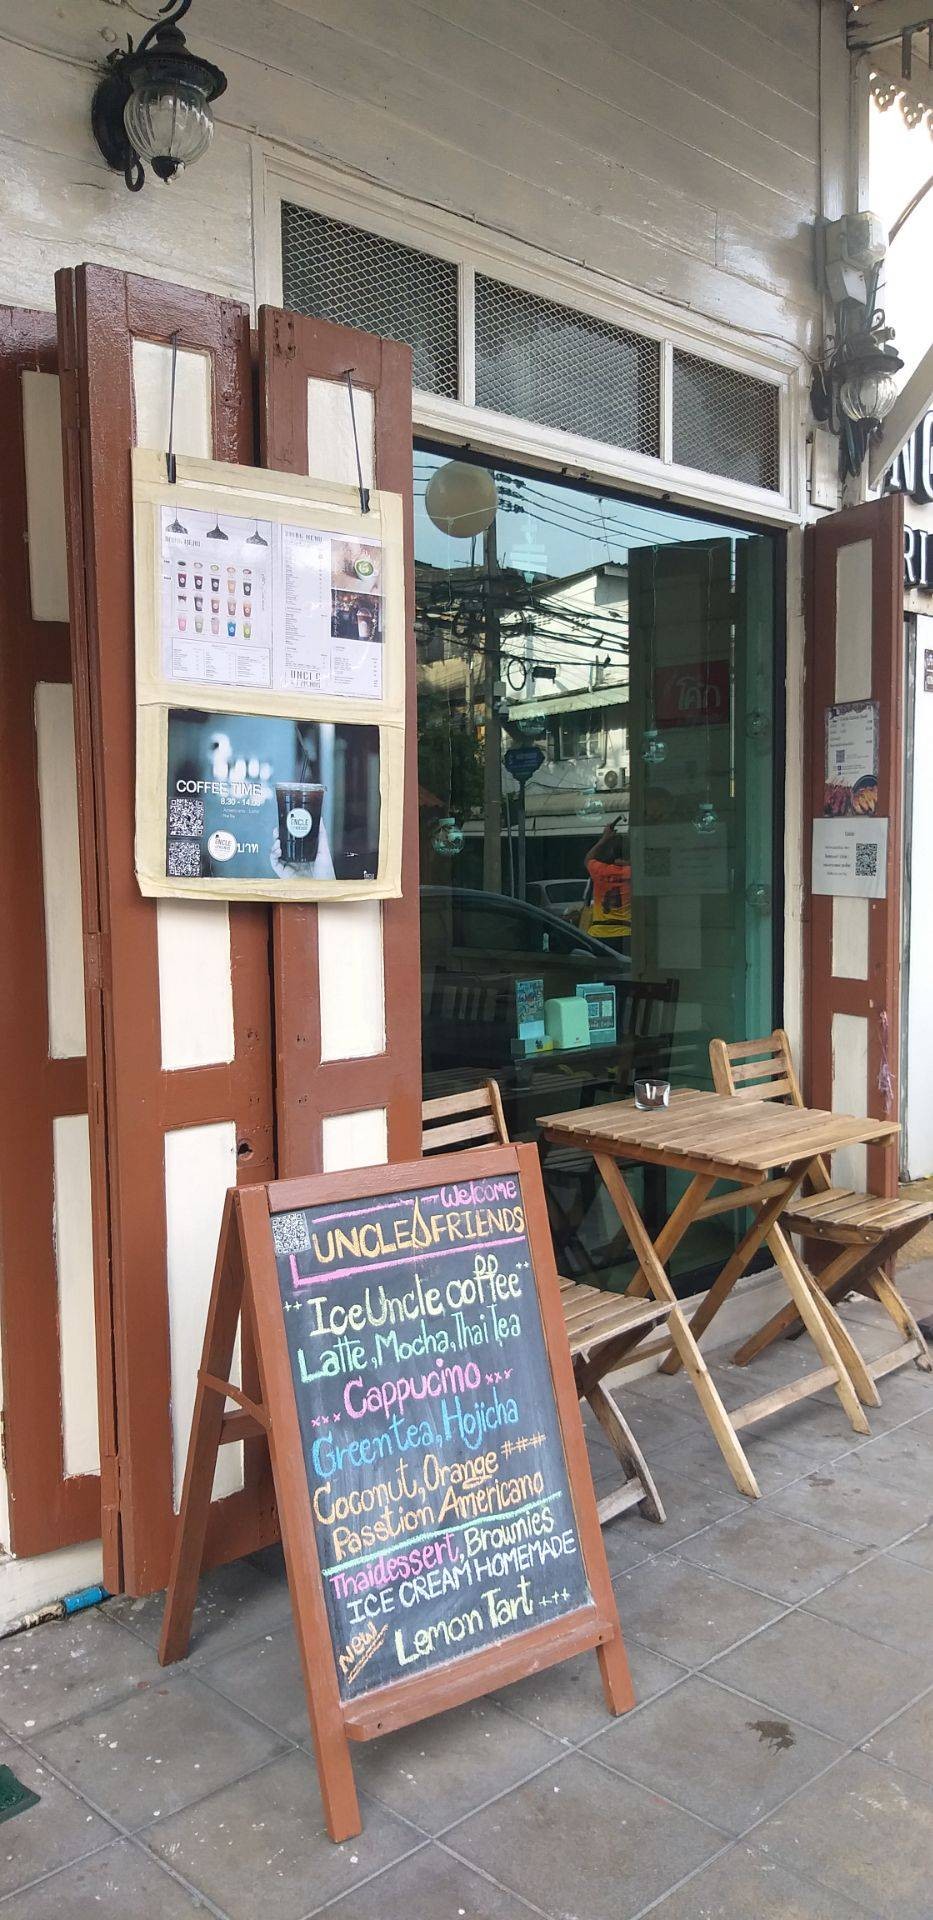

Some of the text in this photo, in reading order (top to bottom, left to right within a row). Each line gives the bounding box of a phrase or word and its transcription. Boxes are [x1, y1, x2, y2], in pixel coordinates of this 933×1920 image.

[176, 779, 262, 797] COFFEE TIME
[237, 843, 259, 854] บาท
[439, 1180, 518, 1208] Welcome
[311, 1206, 525, 1264] UNCLE FRIENDS
[446, 1253, 523, 1309] coffee
[343, 1358, 481, 1419] Cappucino
[441, 1386, 519, 1450] Hojicha
[423, 1451, 499, 1492] Orange
[438, 1471, 545, 1523] Americano
[464, 1506, 555, 1556] Brownies
[346, 1529, 577, 1625] ICE CREAM HOMEMADE
[394, 1608, 484, 1667] Lemon
[480, 1575, 534, 1630] Tart
